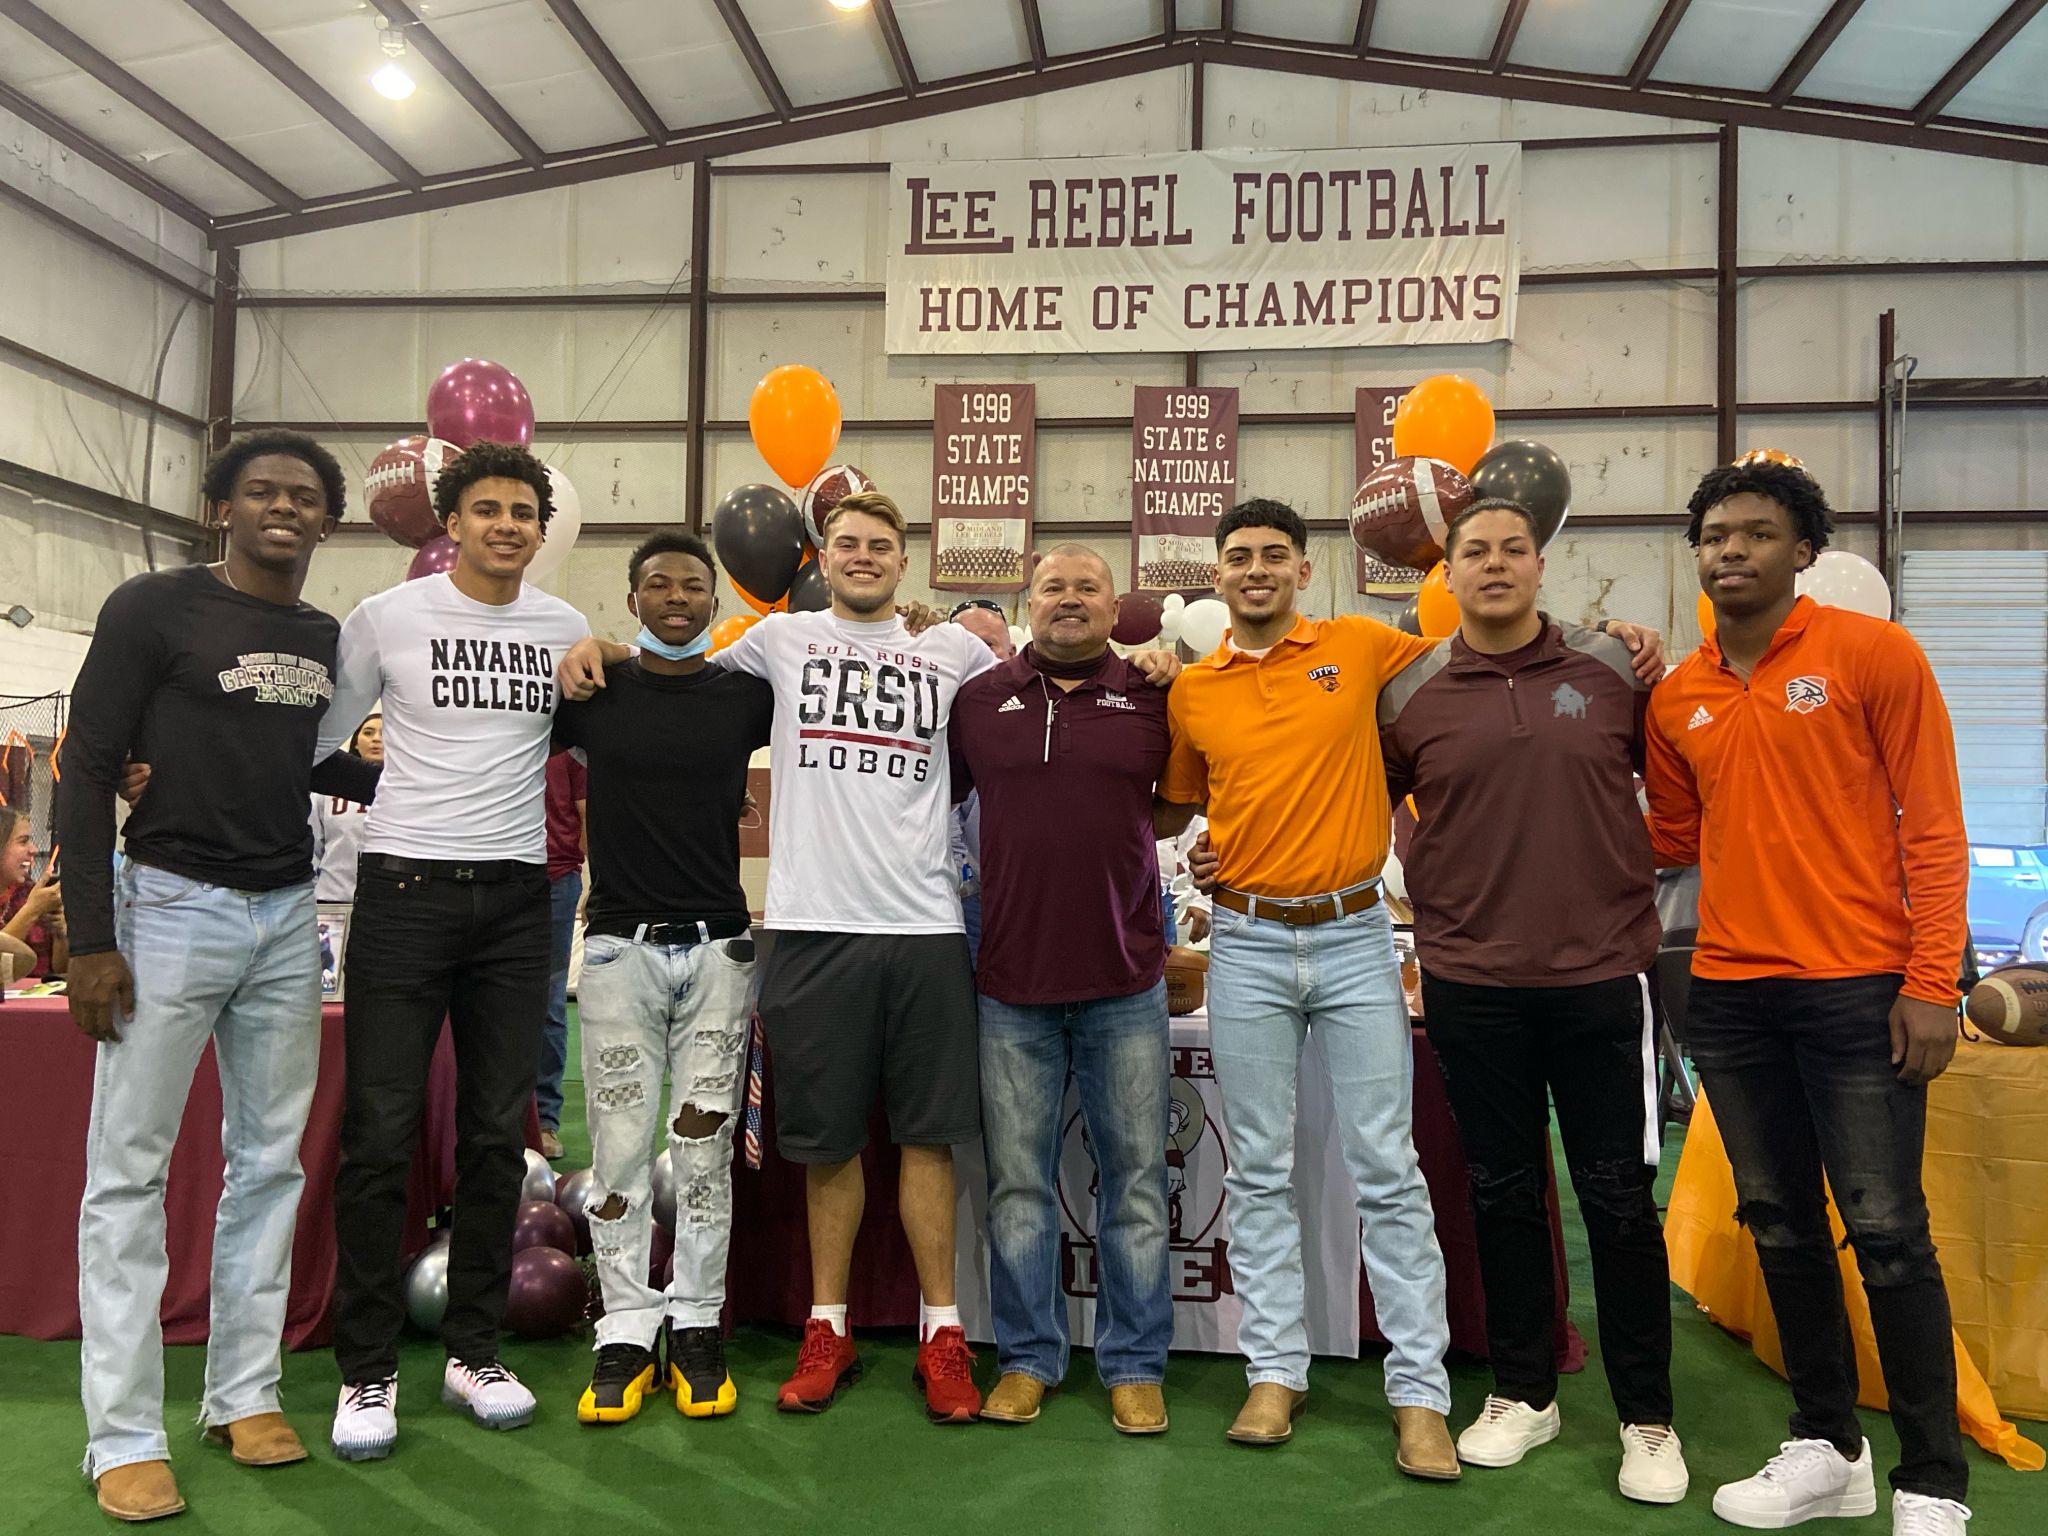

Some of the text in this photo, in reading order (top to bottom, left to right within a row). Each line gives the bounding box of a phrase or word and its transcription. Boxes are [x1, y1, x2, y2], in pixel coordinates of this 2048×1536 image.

[905, 164, 1506, 255] LEE REBEL FOOTBALL
[919, 274, 1503, 333] HOME OF CHAMPIONS
[960, 393, 1012, 424] 1998
[1163, 394, 1210, 419] 1999
[946, 434, 1022, 465] STATE
[1143, 426, 1226, 452] STATE &
[1134, 458, 1235, 485] NATIONAL
[937, 474, 1030, 506] CHAMPS
[1144, 491, 1223, 517] CHAMPS
[430, 638, 553, 678] NAVARRO
[807, 642, 939, 672] SUL ROSS
[1308, 665, 1340, 681] UTPB
[432, 675, 554, 715] COLLEGE
[798, 658, 939, 740] SRSU
[1096, 698, 1136, 710] FOOTBALL
[798, 744, 929, 783] LOBOS
[1071, 1246, 1213, 1298] LE
